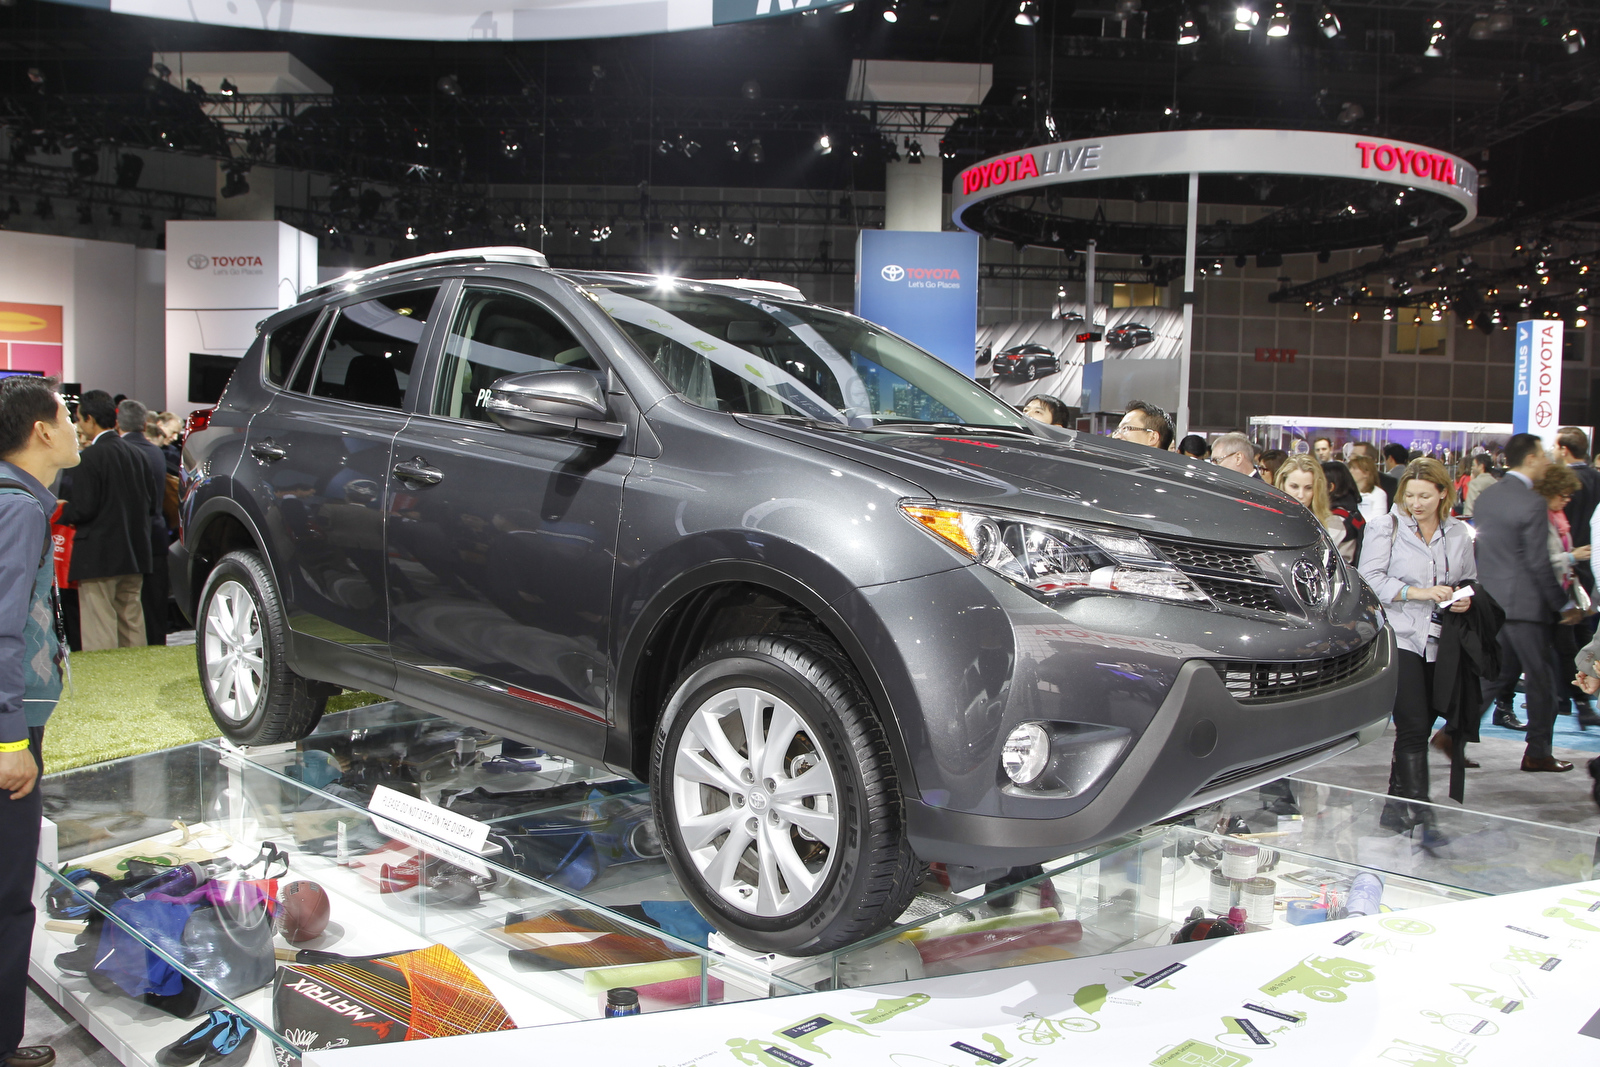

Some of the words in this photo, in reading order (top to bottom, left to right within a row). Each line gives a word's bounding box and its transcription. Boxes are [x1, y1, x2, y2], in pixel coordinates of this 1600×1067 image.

[961, 153, 1038, 195] TOYOTA
[1041, 145, 1103, 176] LIVE
[1356, 141, 1456, 185] TOYOTA
[211, 256, 263, 267] TOYOTA
[906, 268, 961, 280] TOYOTA
[937, 281, 960, 289] Places
[1255, 348, 1298, 363] EXIT
[1519, 327, 1529, 341] v
[1518, 345, 1529, 396] prius
[1539, 325, 1554, 397] TOYOTA
[821, 720, 858, 849] DUELER
[382, 796, 401, 811] PLEASE
[401, 802, 408, 813] DO
[408, 805, 420, 819] NOT
[419, 810, 432, 821] STEP
[431, 815, 441, 825] ON
[441, 818, 451, 830] THE
[451, 822, 474, 839] DISPLAY
[284, 977, 376, 1022] MATRIX
